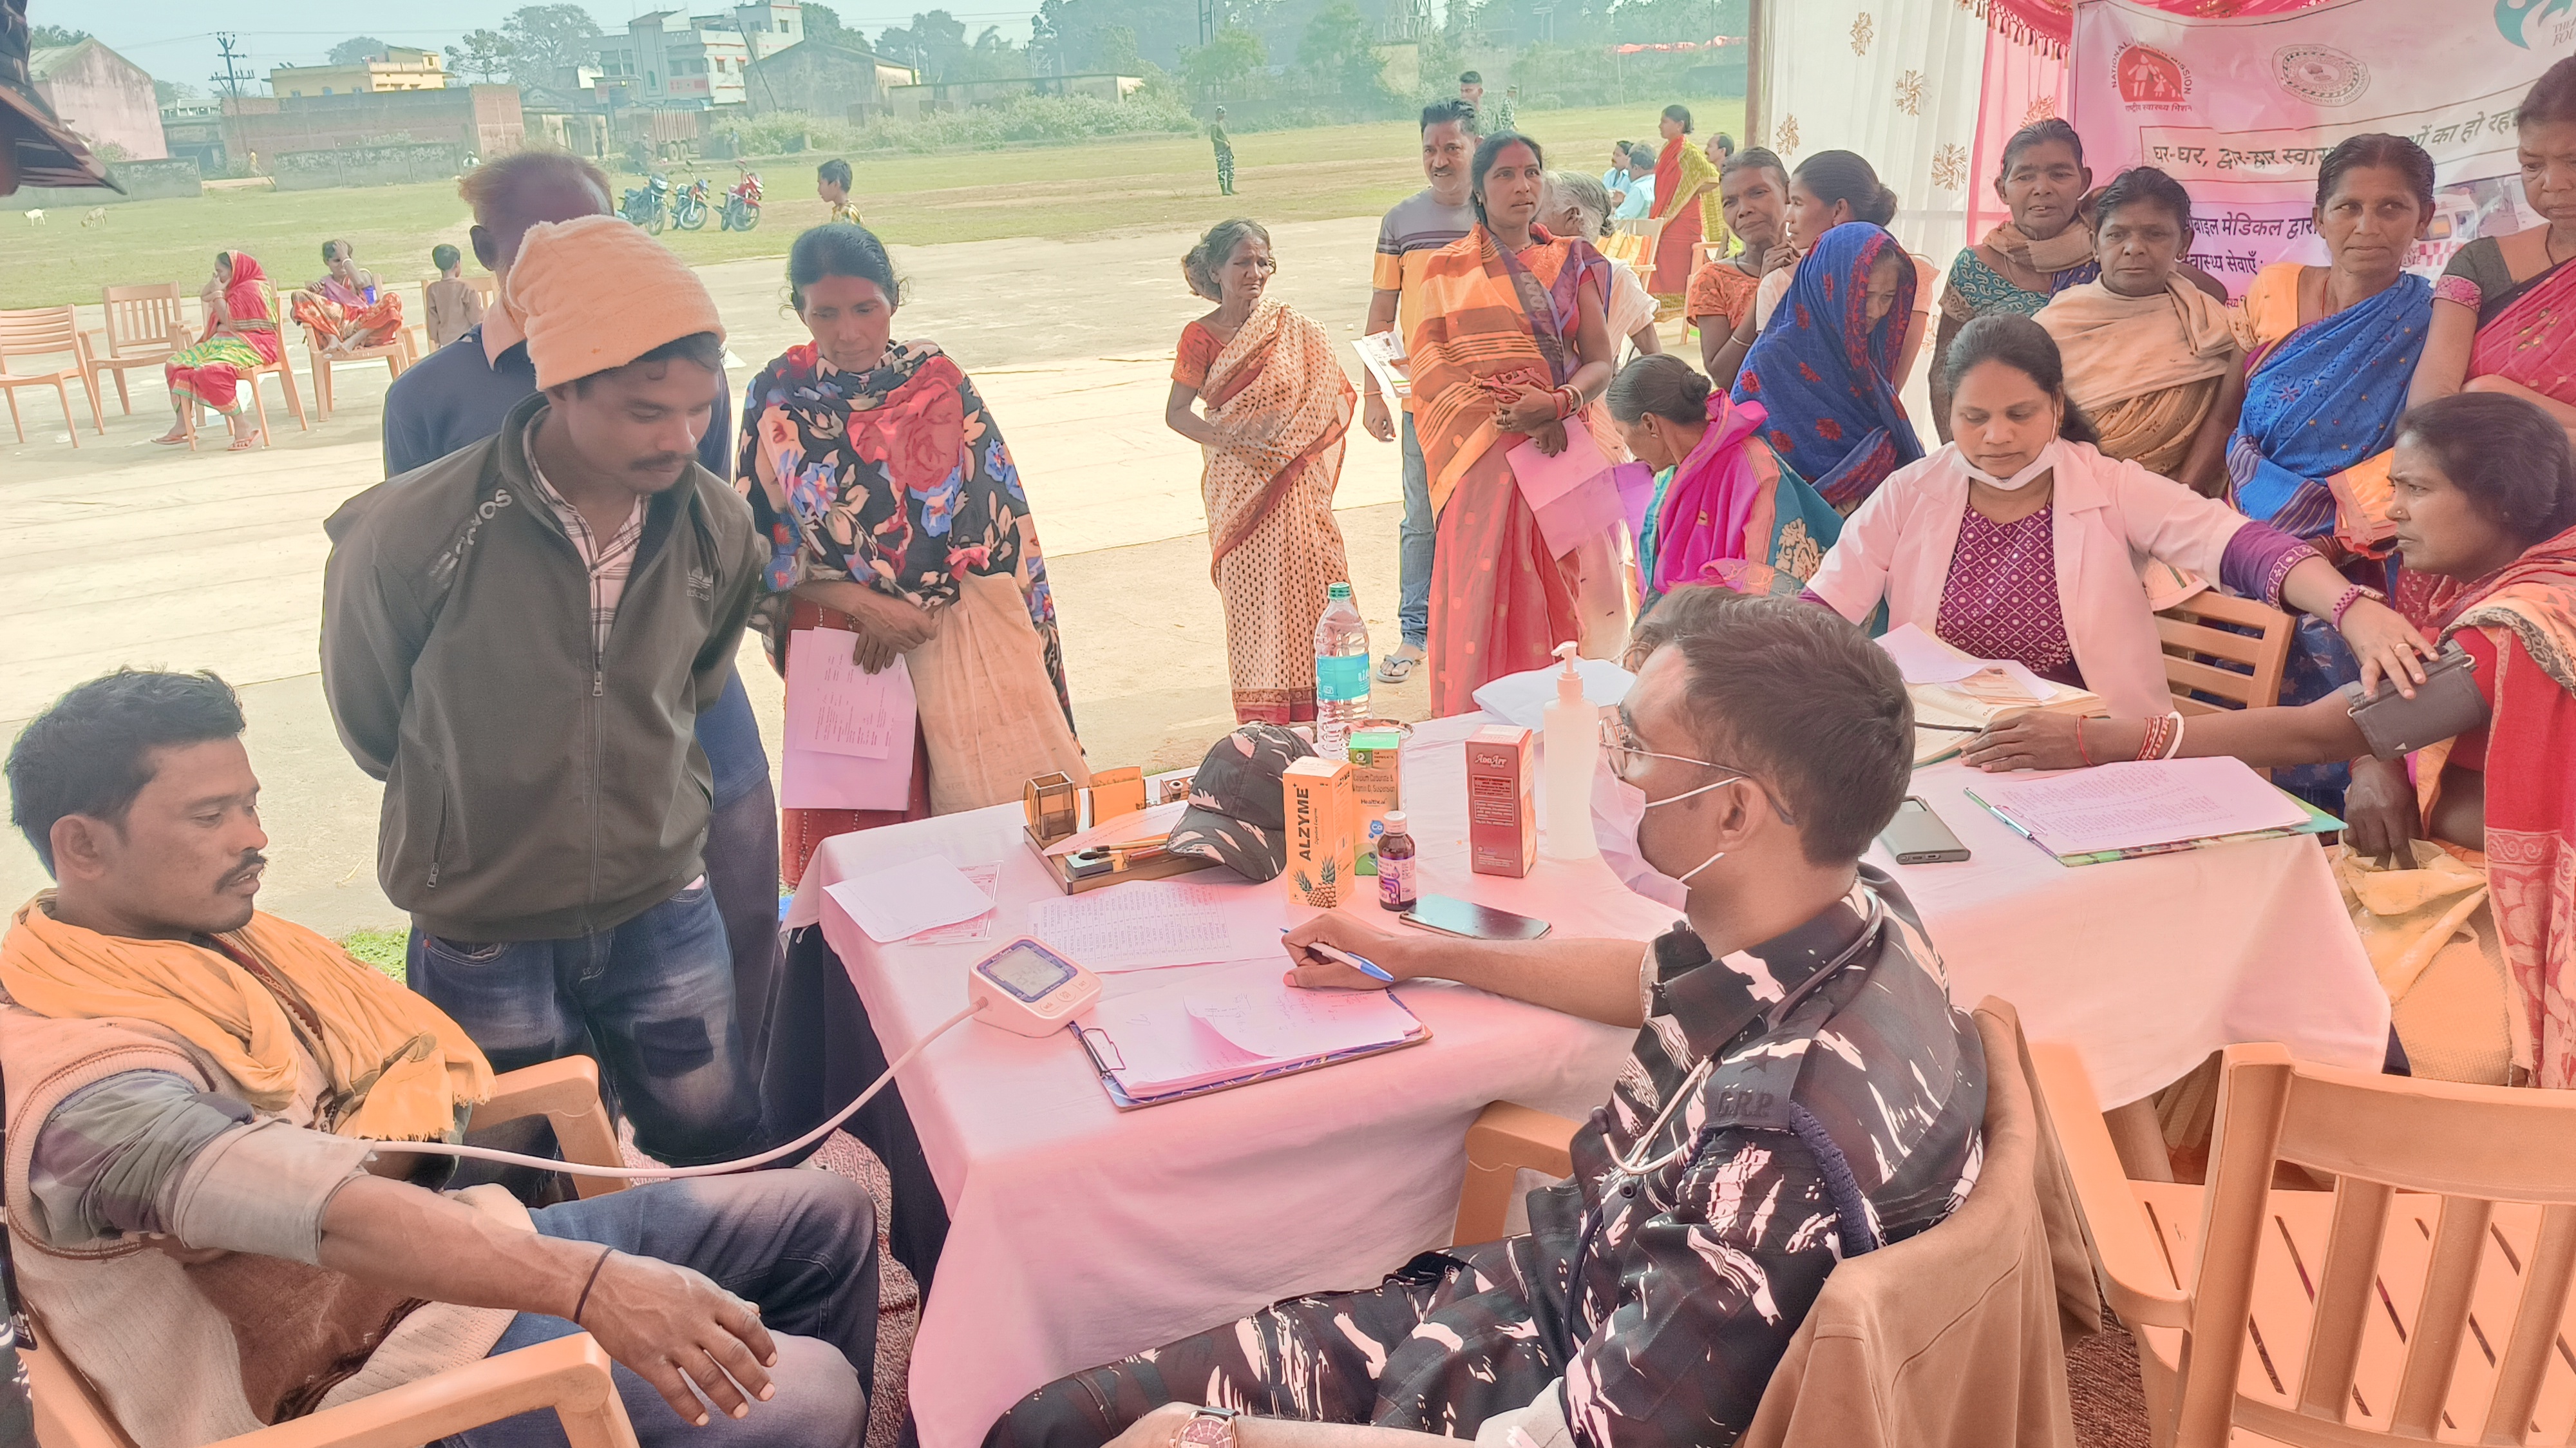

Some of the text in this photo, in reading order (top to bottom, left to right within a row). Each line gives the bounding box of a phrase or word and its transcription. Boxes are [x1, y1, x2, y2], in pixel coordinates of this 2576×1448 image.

[2111, 41, 2131, 88] NATIONAL
[2170, 57, 2192, 95] MISSION
[2171, 102, 2192, 111] मिशन
[2431, 124, 2460, 145] का
[2460, 111, 2486, 143] हो
[2222, 211, 2284, 236] मेडिकल
